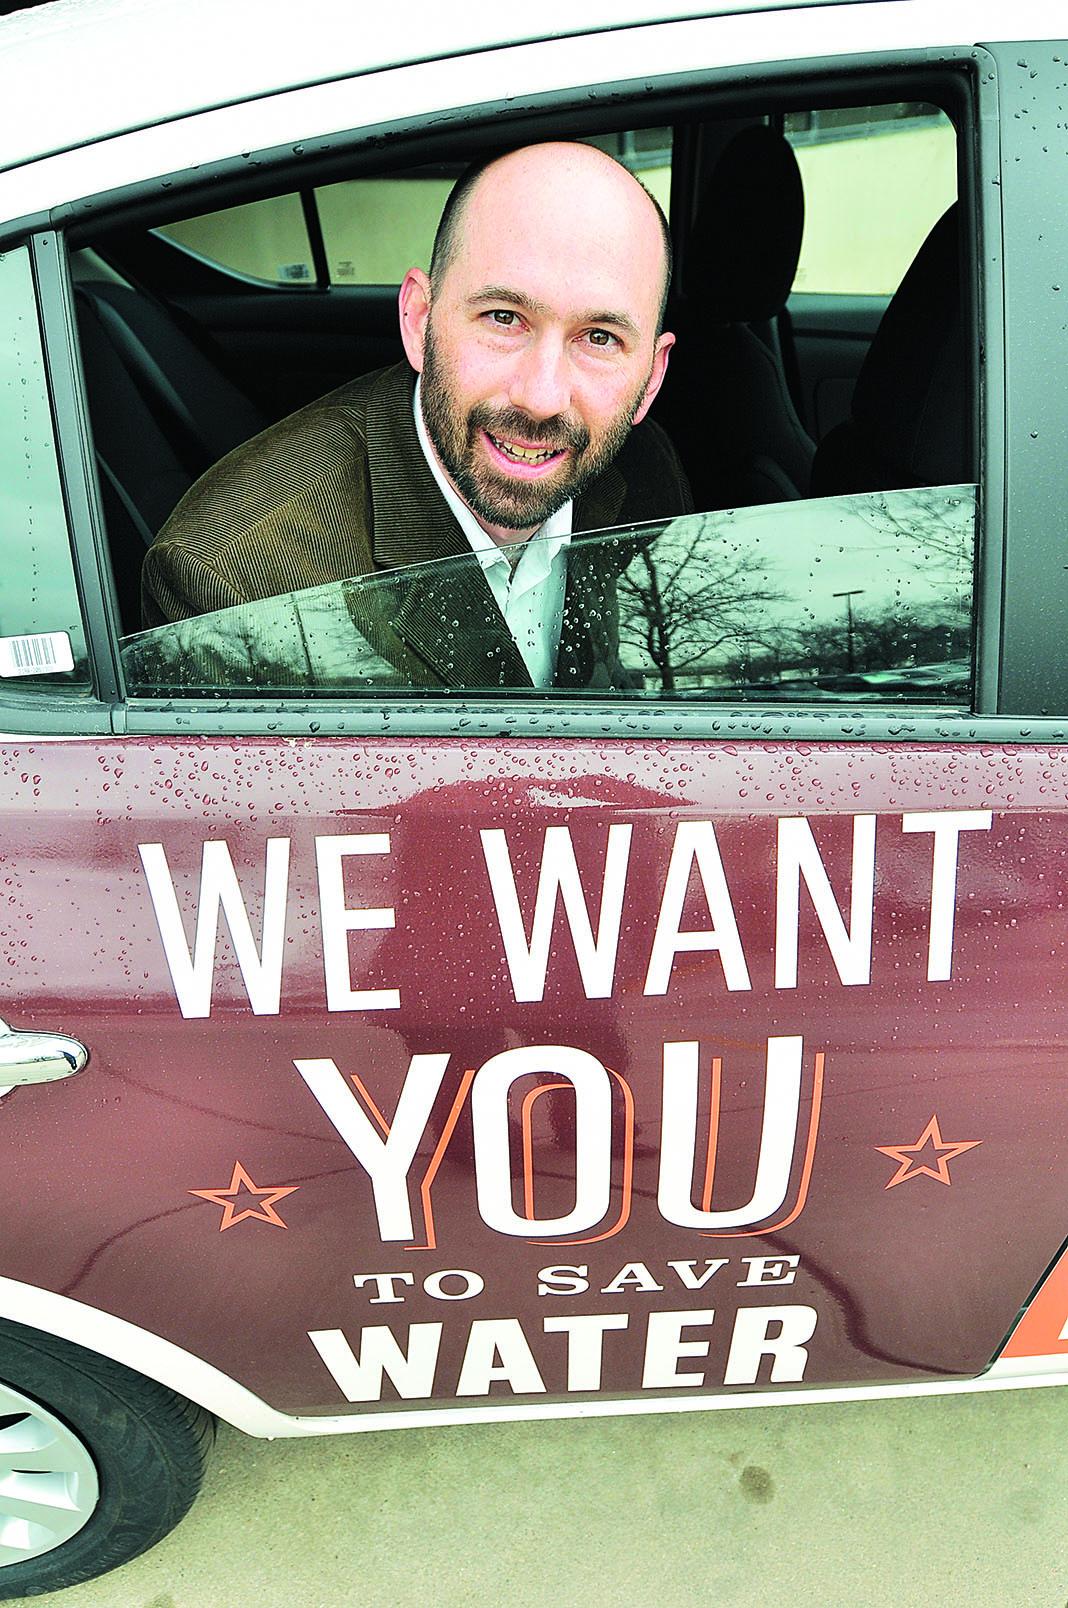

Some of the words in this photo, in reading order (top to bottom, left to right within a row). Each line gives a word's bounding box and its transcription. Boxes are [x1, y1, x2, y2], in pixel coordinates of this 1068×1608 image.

[138, 835, 401, 1019] WE
[480, 809, 993, 1003] WANT
[292, 1035, 825, 1251] YOU
[306, 1304, 818, 1404] WATER
[353, 1268, 485, 1305] TO
[537, 1254, 801, 1297] SAVE
